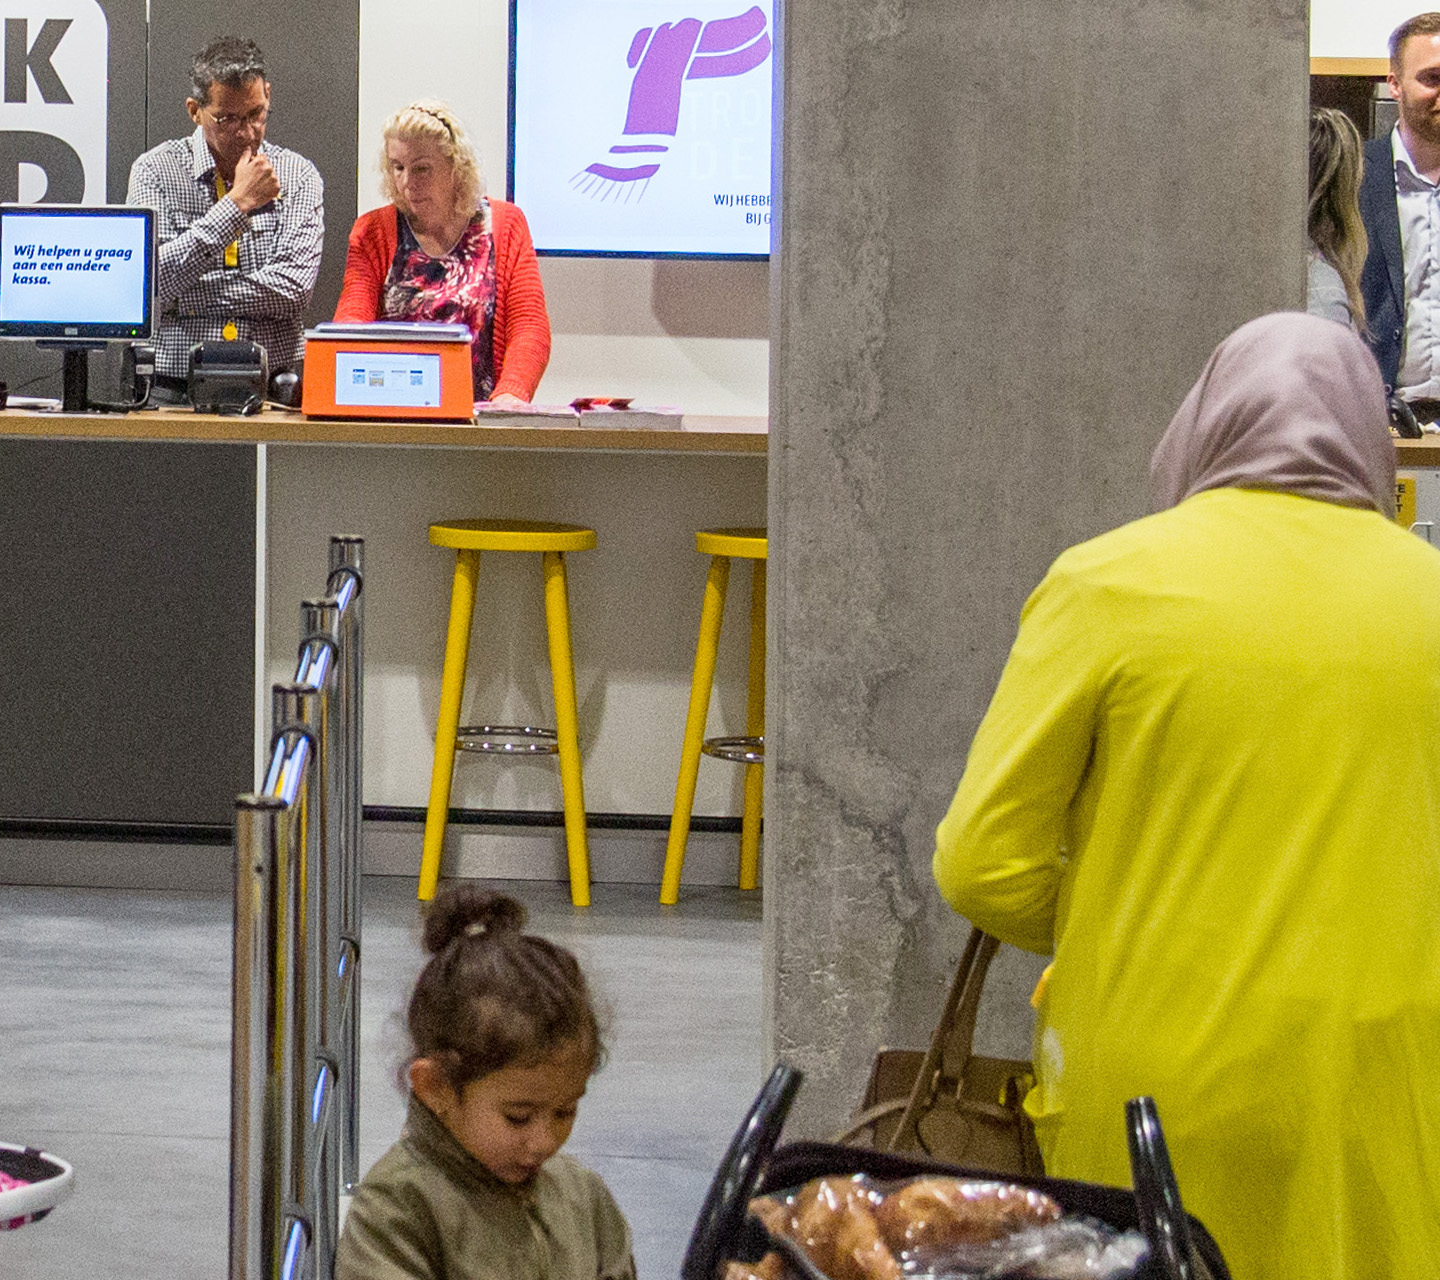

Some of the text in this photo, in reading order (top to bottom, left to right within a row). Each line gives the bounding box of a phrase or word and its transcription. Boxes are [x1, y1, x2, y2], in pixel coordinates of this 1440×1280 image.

[713, 194, 734, 208] WIJ
[745, 213, 762, 226] BIJ
[14, 244, 133, 261] Wij helpen u graag
[12, 260, 112, 272] aan een andere
[12, 272, 51, 285] kassa.
